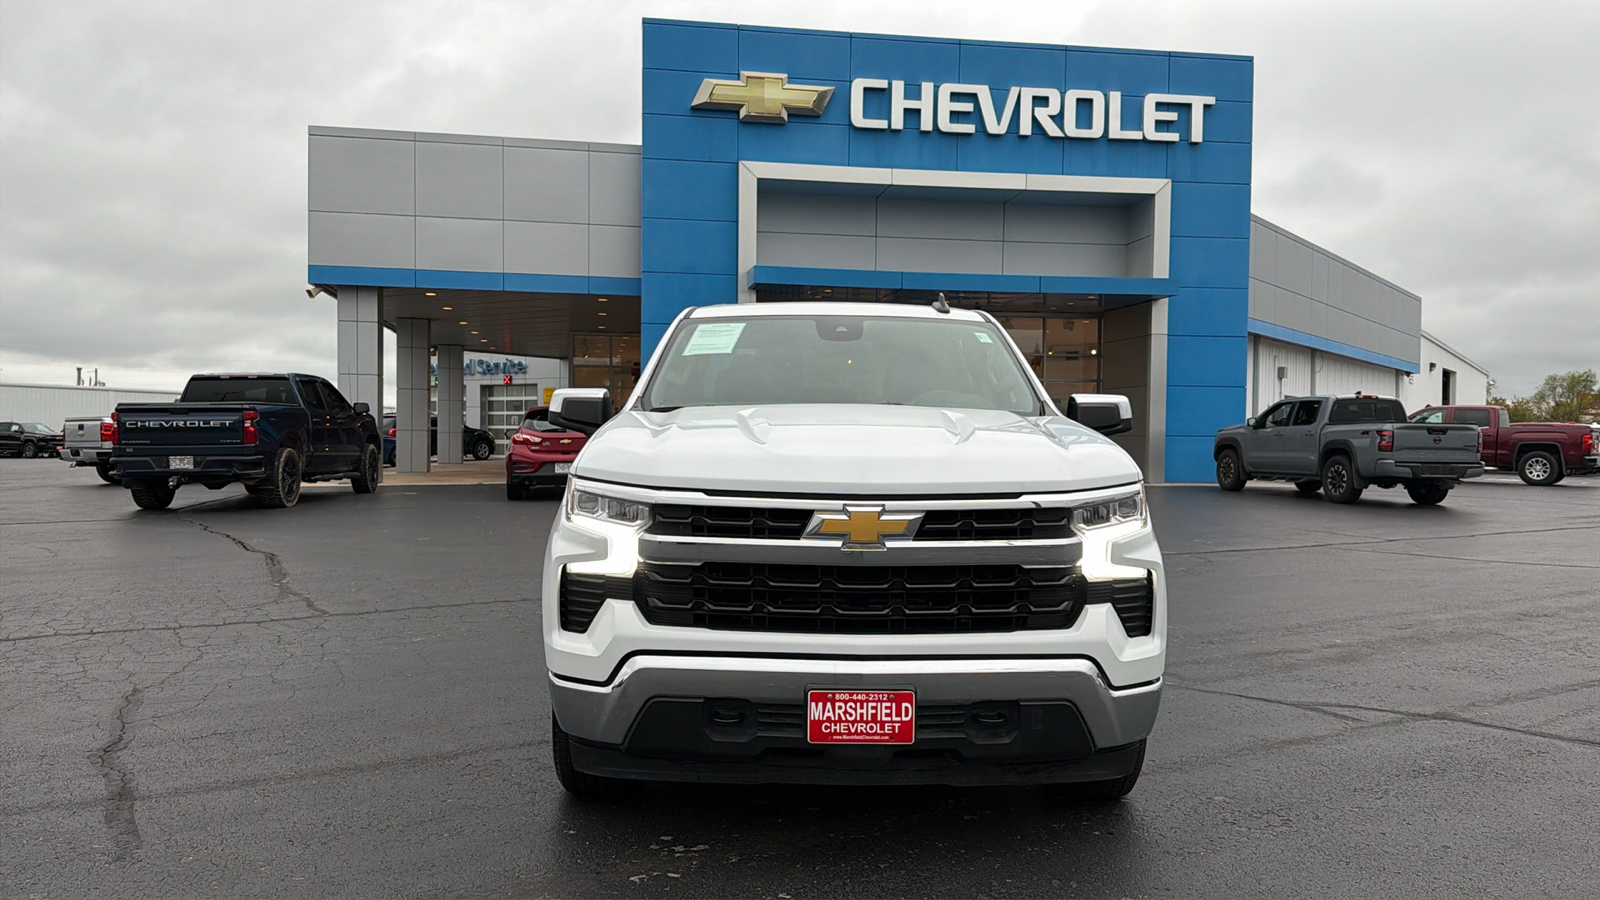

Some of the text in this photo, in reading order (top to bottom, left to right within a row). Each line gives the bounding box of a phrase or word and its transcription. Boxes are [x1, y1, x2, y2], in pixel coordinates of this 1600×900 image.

[850, 77, 1216, 143] CHEVROLET
[477, 358, 525, 375] Service
[126, 420, 233, 428] CHEVROLET
[811, 702, 912, 721] MARSHFIELD
[821, 723, 901, 733] CHEVROLET
